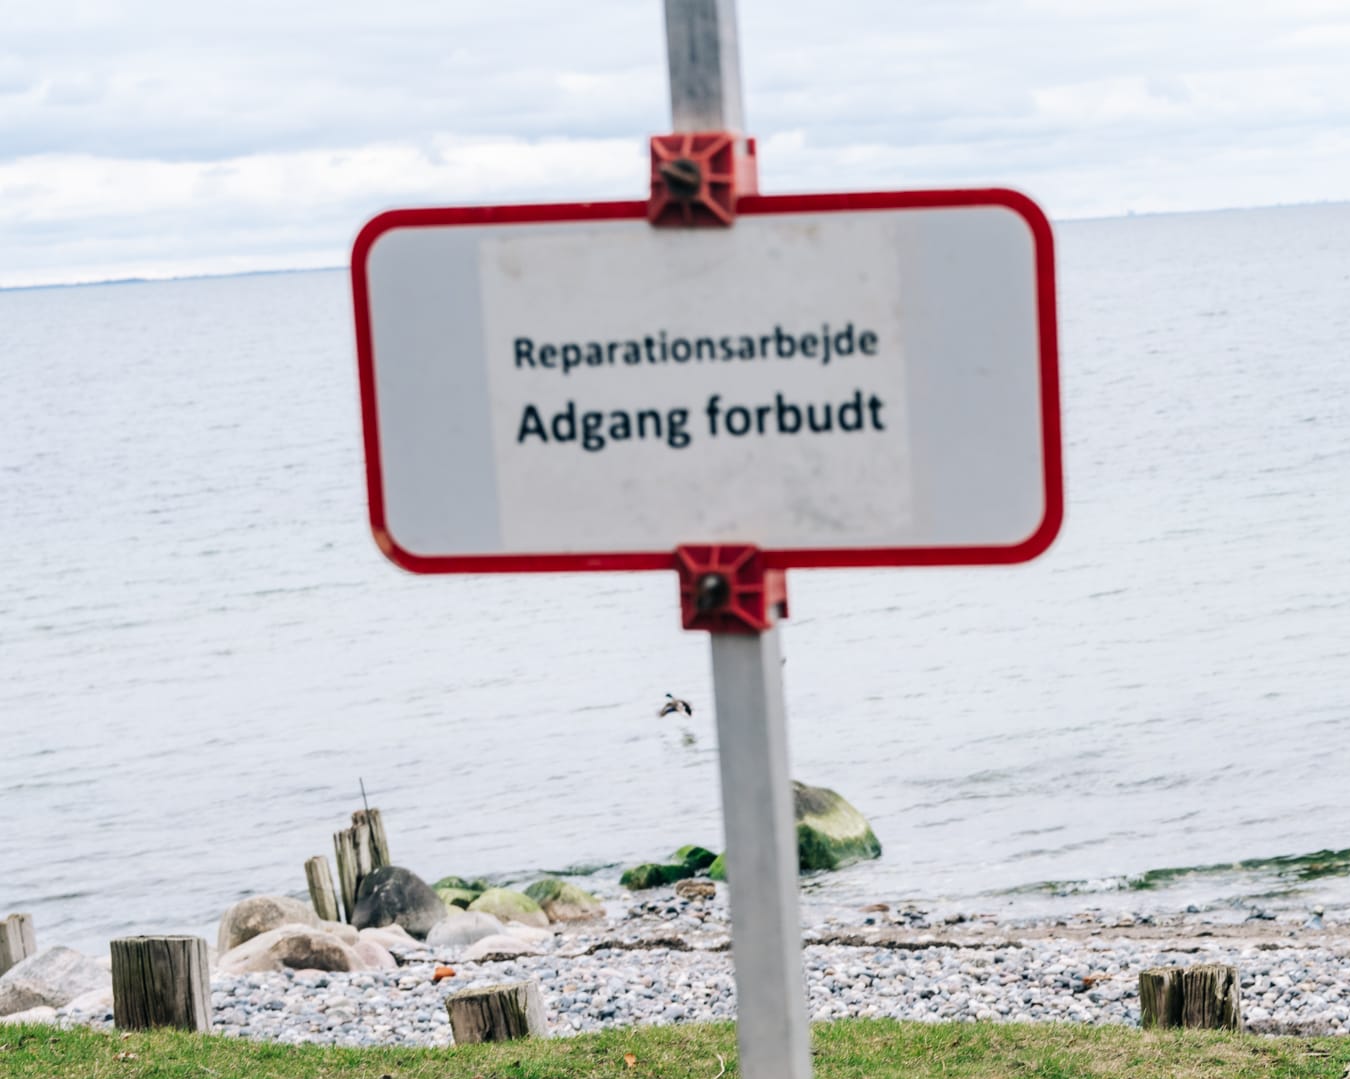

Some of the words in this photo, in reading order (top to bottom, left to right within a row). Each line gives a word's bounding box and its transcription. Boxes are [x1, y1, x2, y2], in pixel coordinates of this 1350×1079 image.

[513, 322, 880, 375] Reparationsarbejde
[516, 400, 693, 453] Adgang
[705, 389, 886, 437] forbudt
